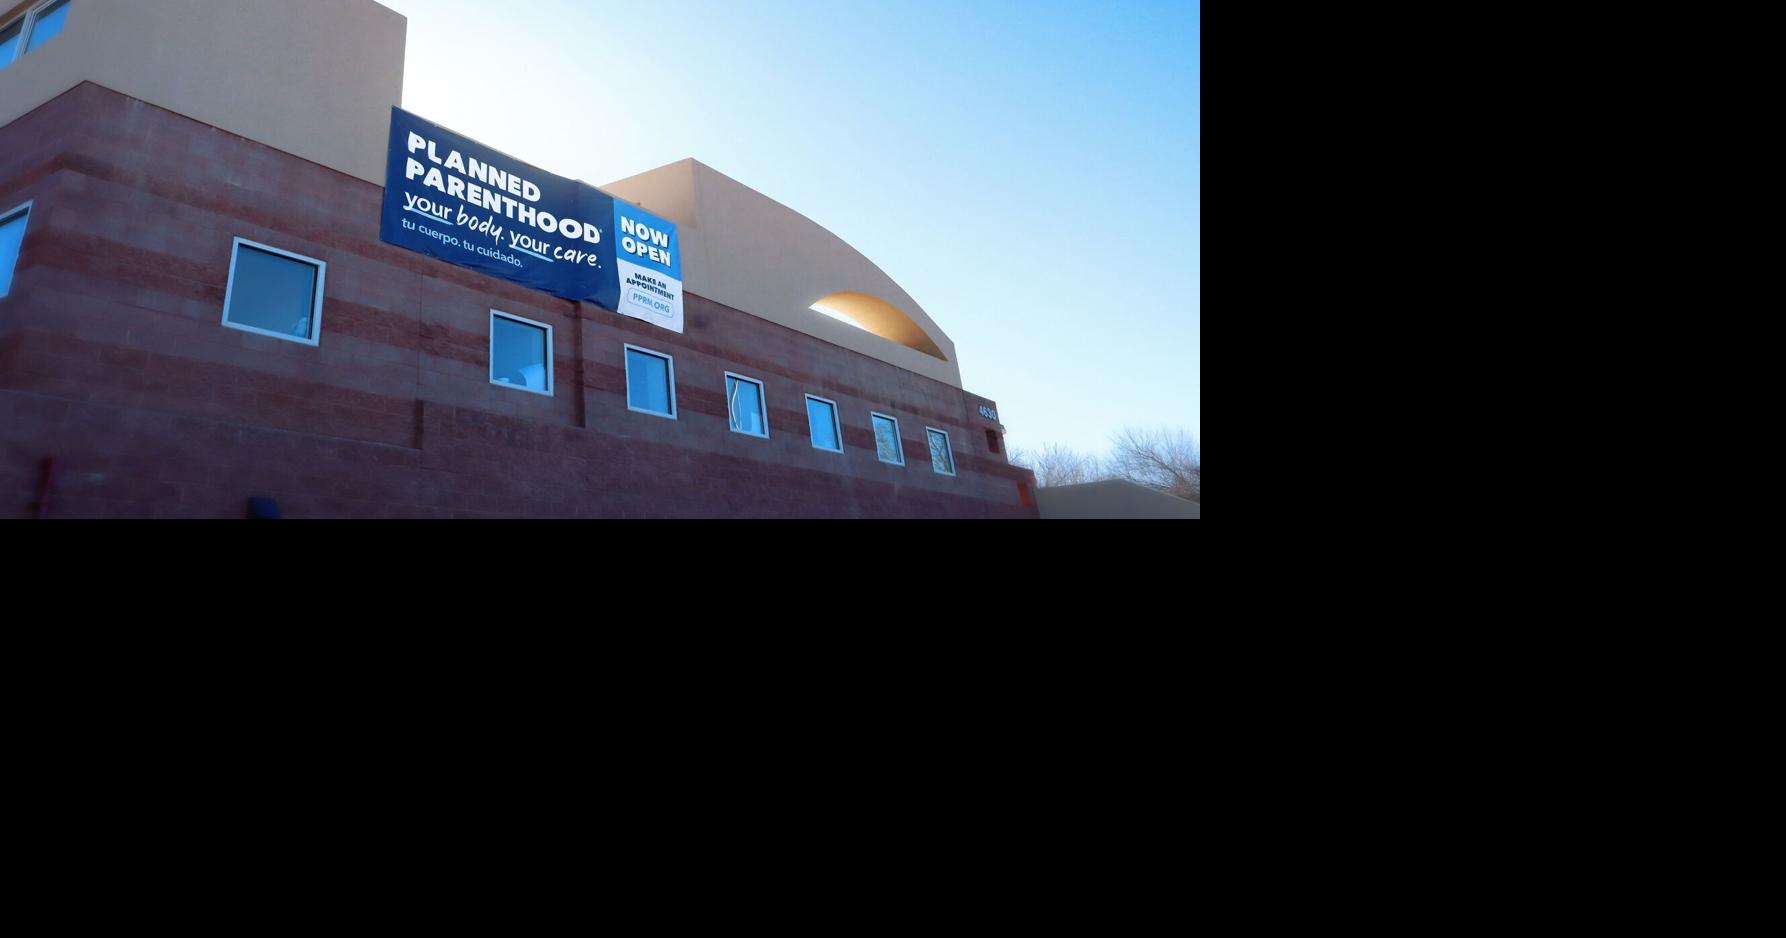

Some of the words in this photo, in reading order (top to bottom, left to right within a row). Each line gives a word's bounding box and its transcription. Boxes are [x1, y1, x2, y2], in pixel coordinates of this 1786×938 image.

[408, 131, 541, 202] PLANNED
[406, 157, 601, 244] PARENTHOOD
[401, 217, 416, 230] tu
[418, 223, 461, 248] cuerpo.
[462, 240, 475, 252] tu
[476, 244, 523, 268] cuidado.
[404, 191, 453, 220] your
[456, 204, 505, 245] body.
[510, 230, 550, 255] your
[553, 245, 602, 269] care.
[621, 216, 669, 248] NOW
[621, 240, 672, 267] OPEN
[626, 277, 675, 301] APPOINTMENT
[634, 273, 656, 285] MAKE
[656, 279, 667, 289] AN
